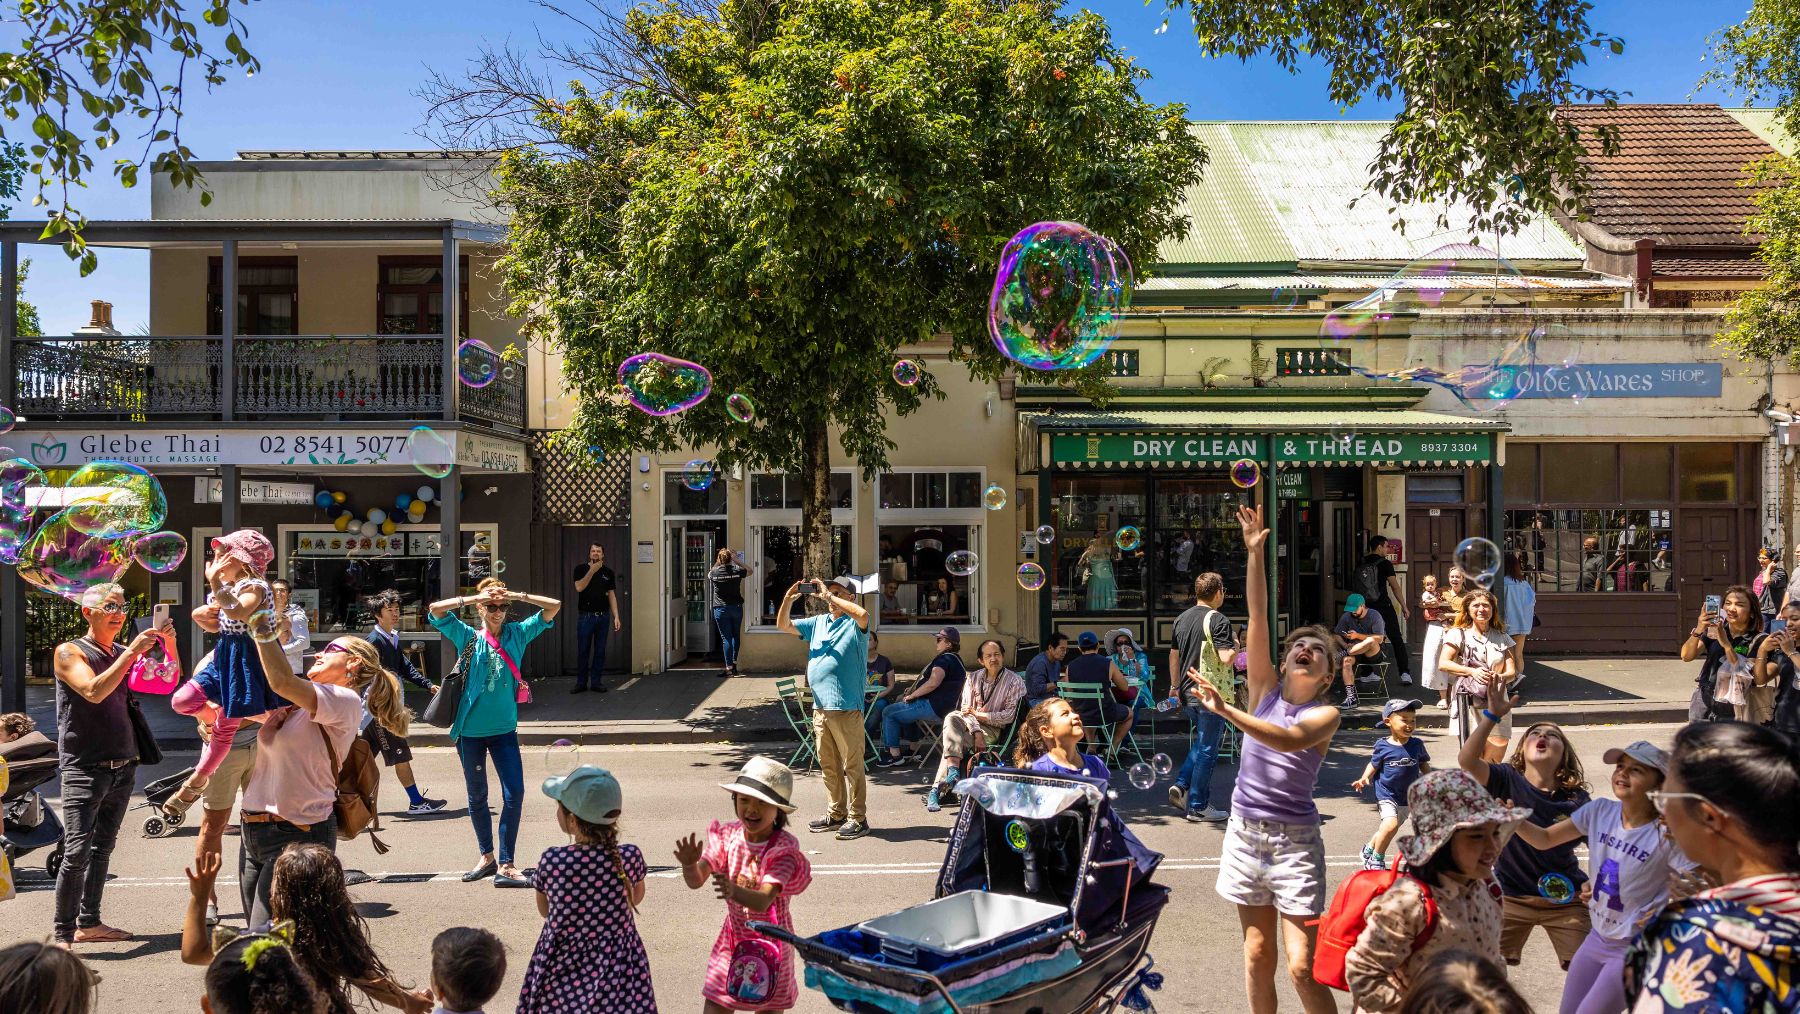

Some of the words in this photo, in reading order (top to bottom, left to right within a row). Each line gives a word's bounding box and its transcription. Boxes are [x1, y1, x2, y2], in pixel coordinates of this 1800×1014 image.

[1661, 369, 1704, 382] SHOP
[80, 434, 152, 453] Glebe
[164, 434, 221, 453] Thai
[260, 436, 285, 453] 02
[294, 436, 345, 453] 8541
[356, 436, 408, 453] 5077
[1133, 440, 1176, 456] DRY
[1184, 440, 1257, 456] CLEAN
[1283, 440, 1297, 456] &
[1306, 440, 1403, 456] THREAD
[1421, 443, 1448, 452] 8937
[1451, 443, 1478, 452] 3304
[241, 484, 259, 498] ebe
[1380, 513, 1400, 529] 71
[1597, 831, 1650, 862] NSPIRE
[1592, 857, 1625, 912] A
